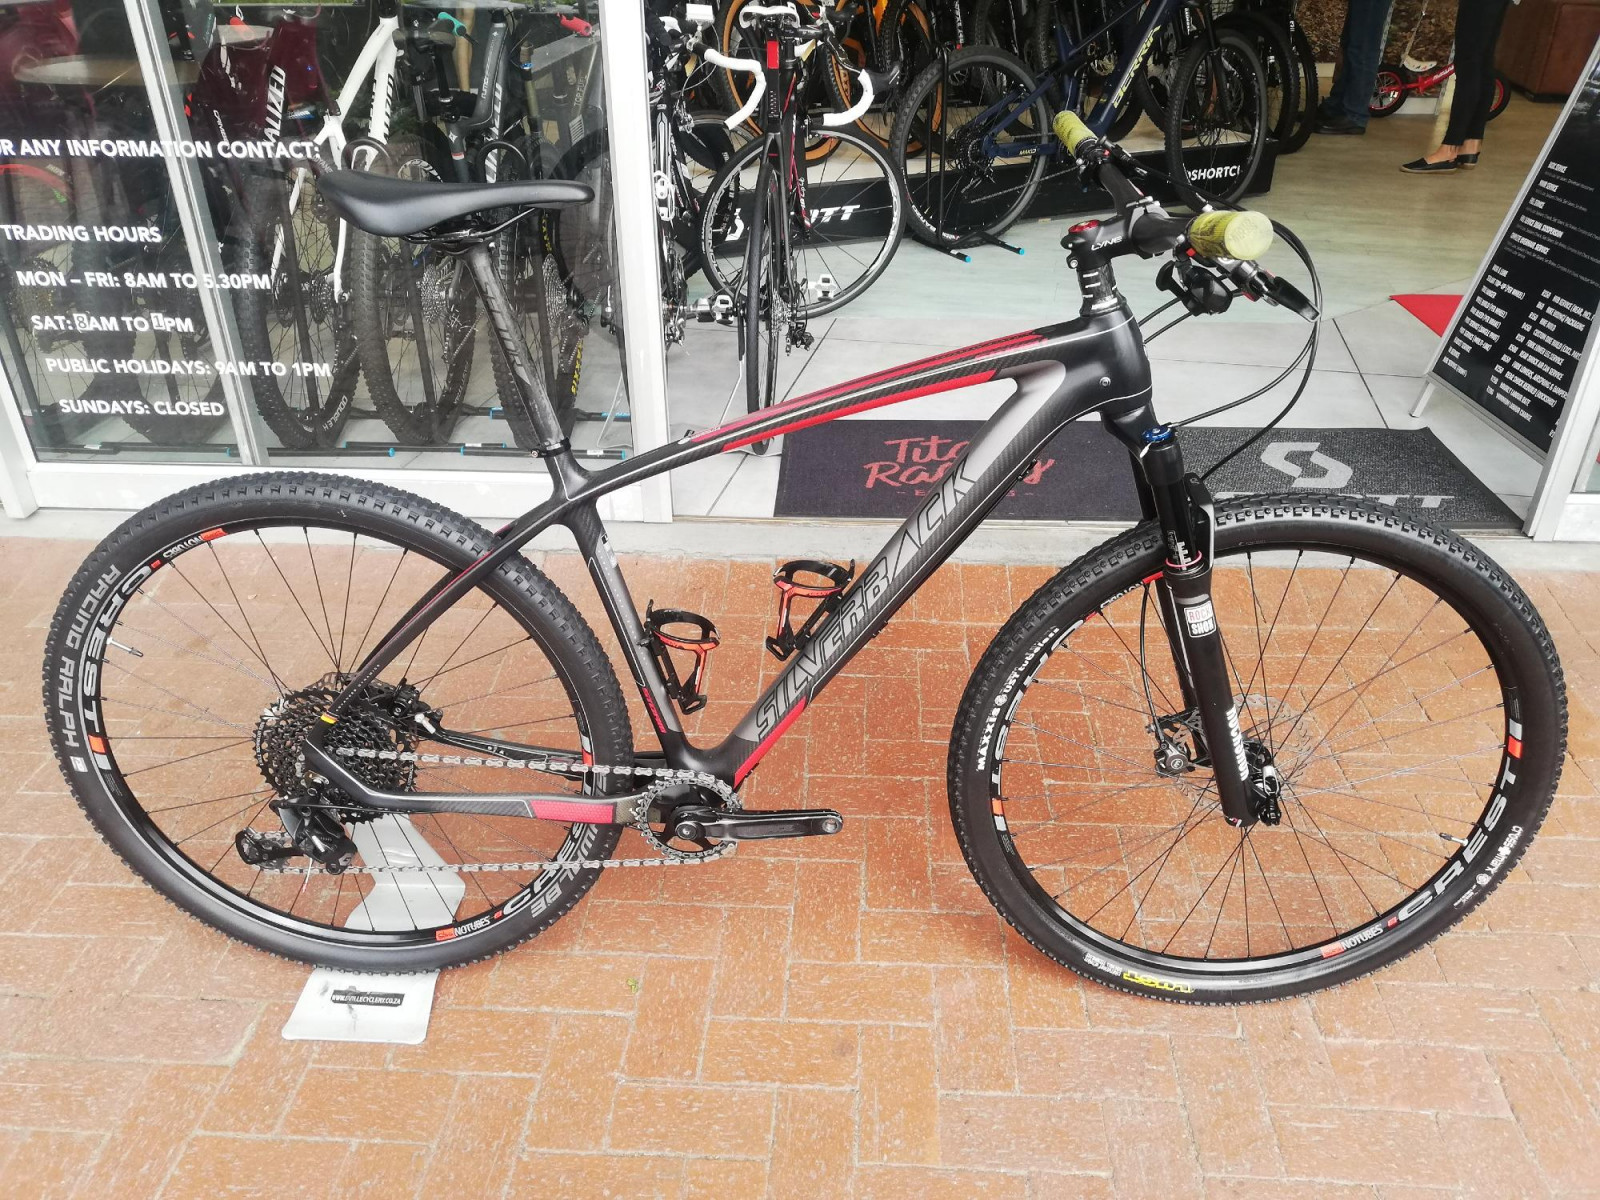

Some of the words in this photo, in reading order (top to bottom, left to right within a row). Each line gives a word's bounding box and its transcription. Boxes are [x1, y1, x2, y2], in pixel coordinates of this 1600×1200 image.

[20, 140, 60, 156] ANY
[67, 140, 212, 158] INFORMATION
[217, 141, 320, 159] CONTACT:
[1, 226, 90, 242] TRADING
[94, 227, 162, 243] HOURS
[1091, 236, 1123, 251] LYNE
[16, 271, 67, 287] MON
[85, 272, 120, 287] FRI:
[124, 273, 167, 288] 8AM
[172, 273, 198, 288] TO
[204, 274, 272, 289] 5.30PM
[31, 316, 72, 331] SAT:
[73, 314, 119, 333] 8AM
[123, 316, 149, 331] TO
[151, 313, 194, 333] 1PM
[45, 359, 111, 374] PUBLIC
[114, 360, 210, 375] HOLIDAYS:
[216, 361, 256, 376] 9AM
[259, 362, 286, 377] TO
[292, 363, 333, 378] 1PM
[59, 400, 150, 415] SUNDAYS:
[154, 401, 224, 416] CLOSED
[66, 564, 122, 650] RACING
[756, 458, 978, 741] SILVERBACK
[83, 565, 151, 733] CREST
[58, 656, 80, 748] RALPH
[1398, 757, 1517, 922] CREST
[454, 917, 492, 937] NOTUBES
[1342, 924, 1384, 950] NOTUBES
